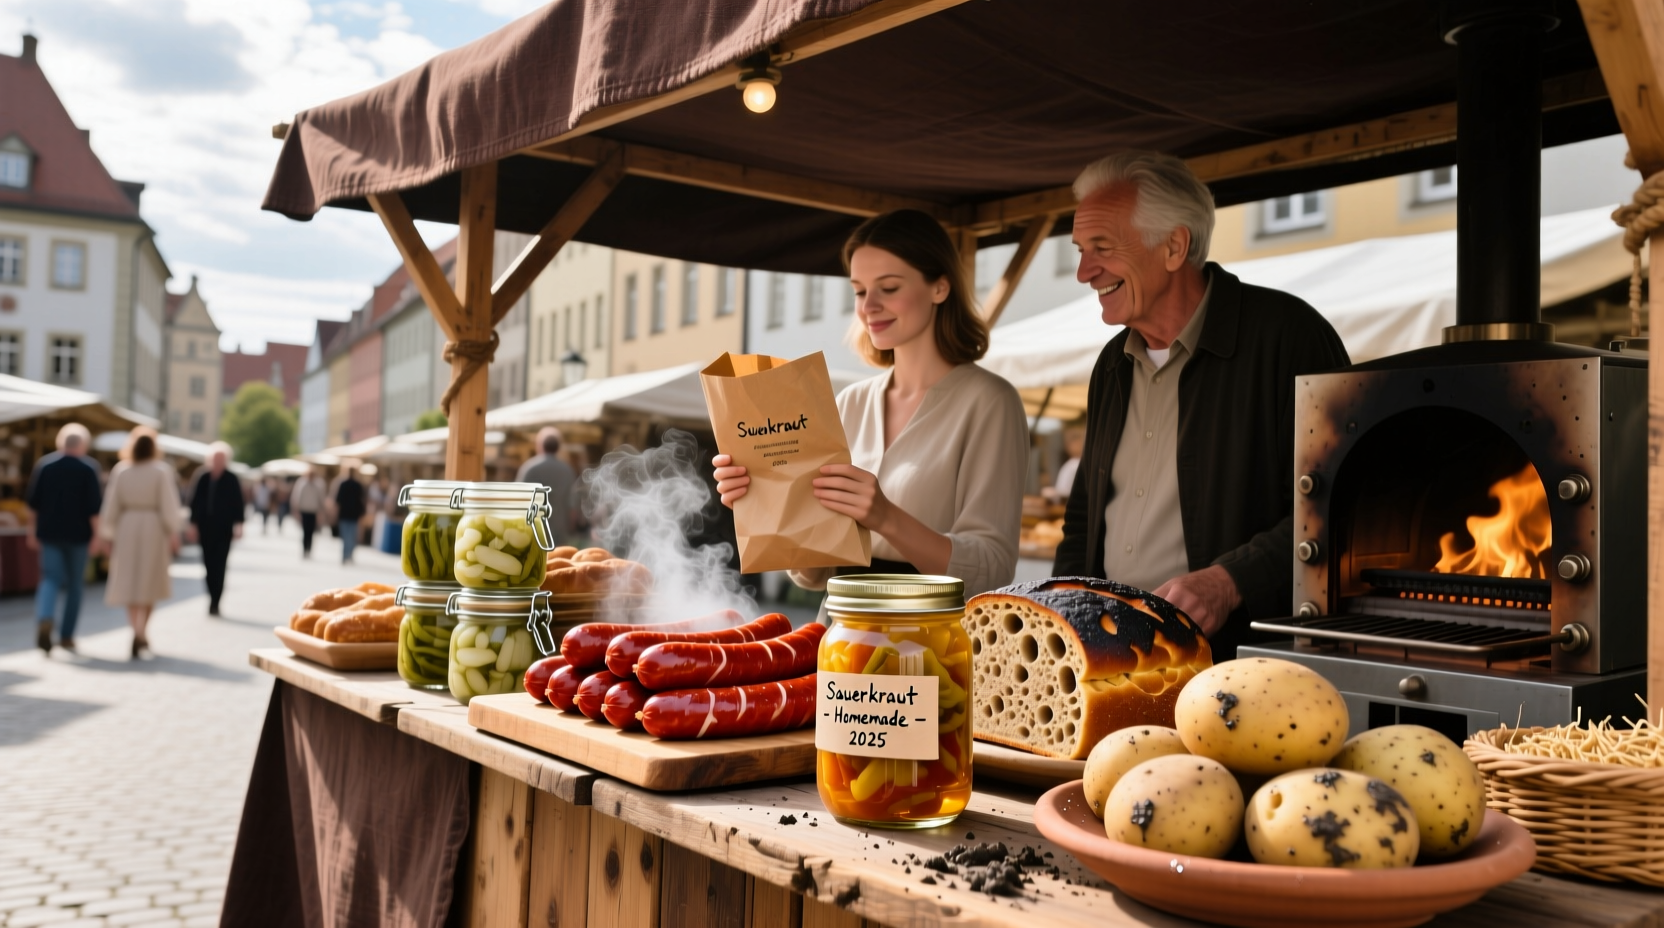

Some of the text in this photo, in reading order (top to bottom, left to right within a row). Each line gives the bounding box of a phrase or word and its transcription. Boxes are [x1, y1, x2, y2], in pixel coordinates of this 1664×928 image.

[826, 681, 919, 705] Sauerkraut
[834, 706, 909, 728] Homemade
[848, 730, 887, 748] 2025
